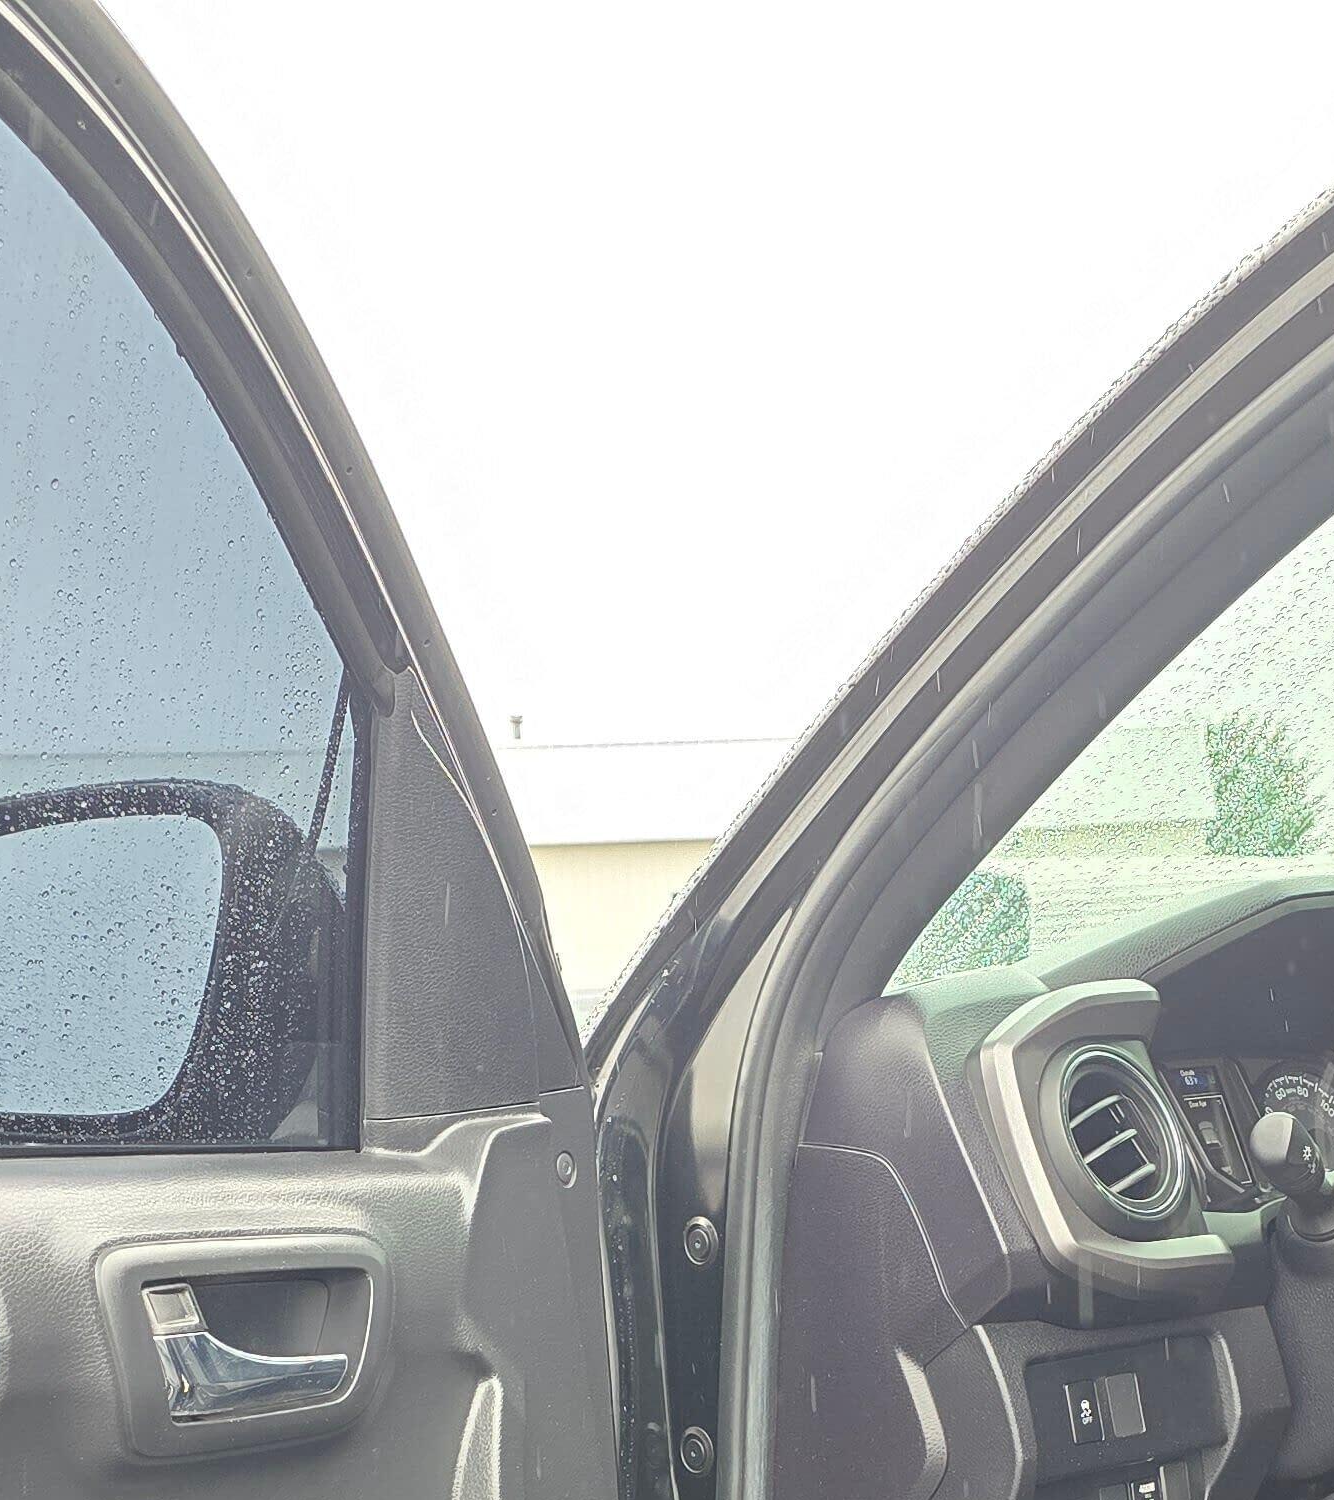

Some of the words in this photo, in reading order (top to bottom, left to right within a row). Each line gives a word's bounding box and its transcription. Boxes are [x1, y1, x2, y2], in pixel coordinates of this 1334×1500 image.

[1275, 1088, 1286, 1100] 60
[1297, 1086, 1309, 1097] 80
[1320, 1100, 1334, 1117] 100
[1082, 1416, 1093, 1425] OFF
